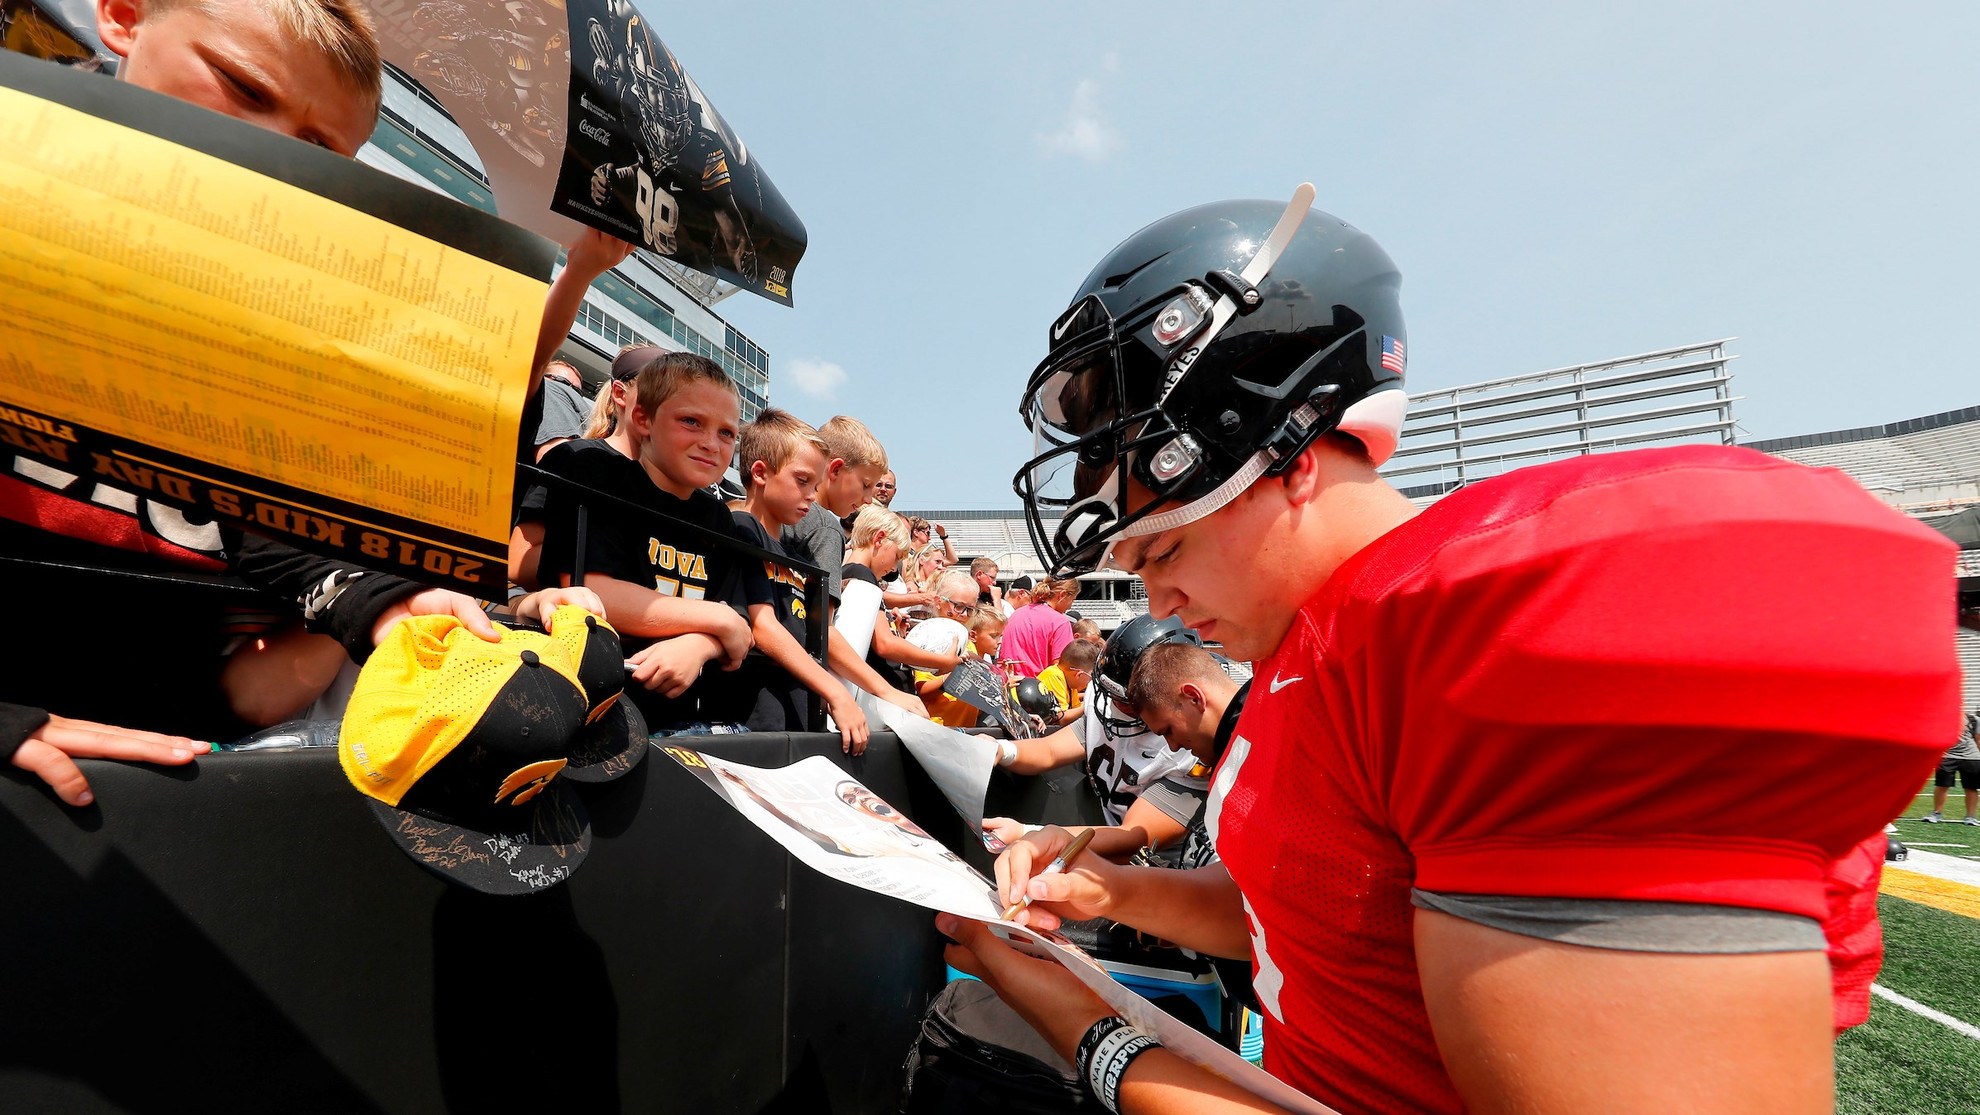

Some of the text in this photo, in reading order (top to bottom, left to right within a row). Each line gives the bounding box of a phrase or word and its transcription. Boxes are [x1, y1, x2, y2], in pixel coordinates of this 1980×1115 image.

[578, 118, 611, 148] Coca-Cola
[635, 166, 680, 256] 98
[769, 265, 786, 284] 2018
[90, 452, 197, 504] DAY
[208, 488, 346, 548] KID'S
[359, 532, 484, 583] 2018
[648, 537, 709, 582] IOWA
[351, 742, 393, 786] DRI-FIT
[1092, 1046, 1110, 1085] NAME
